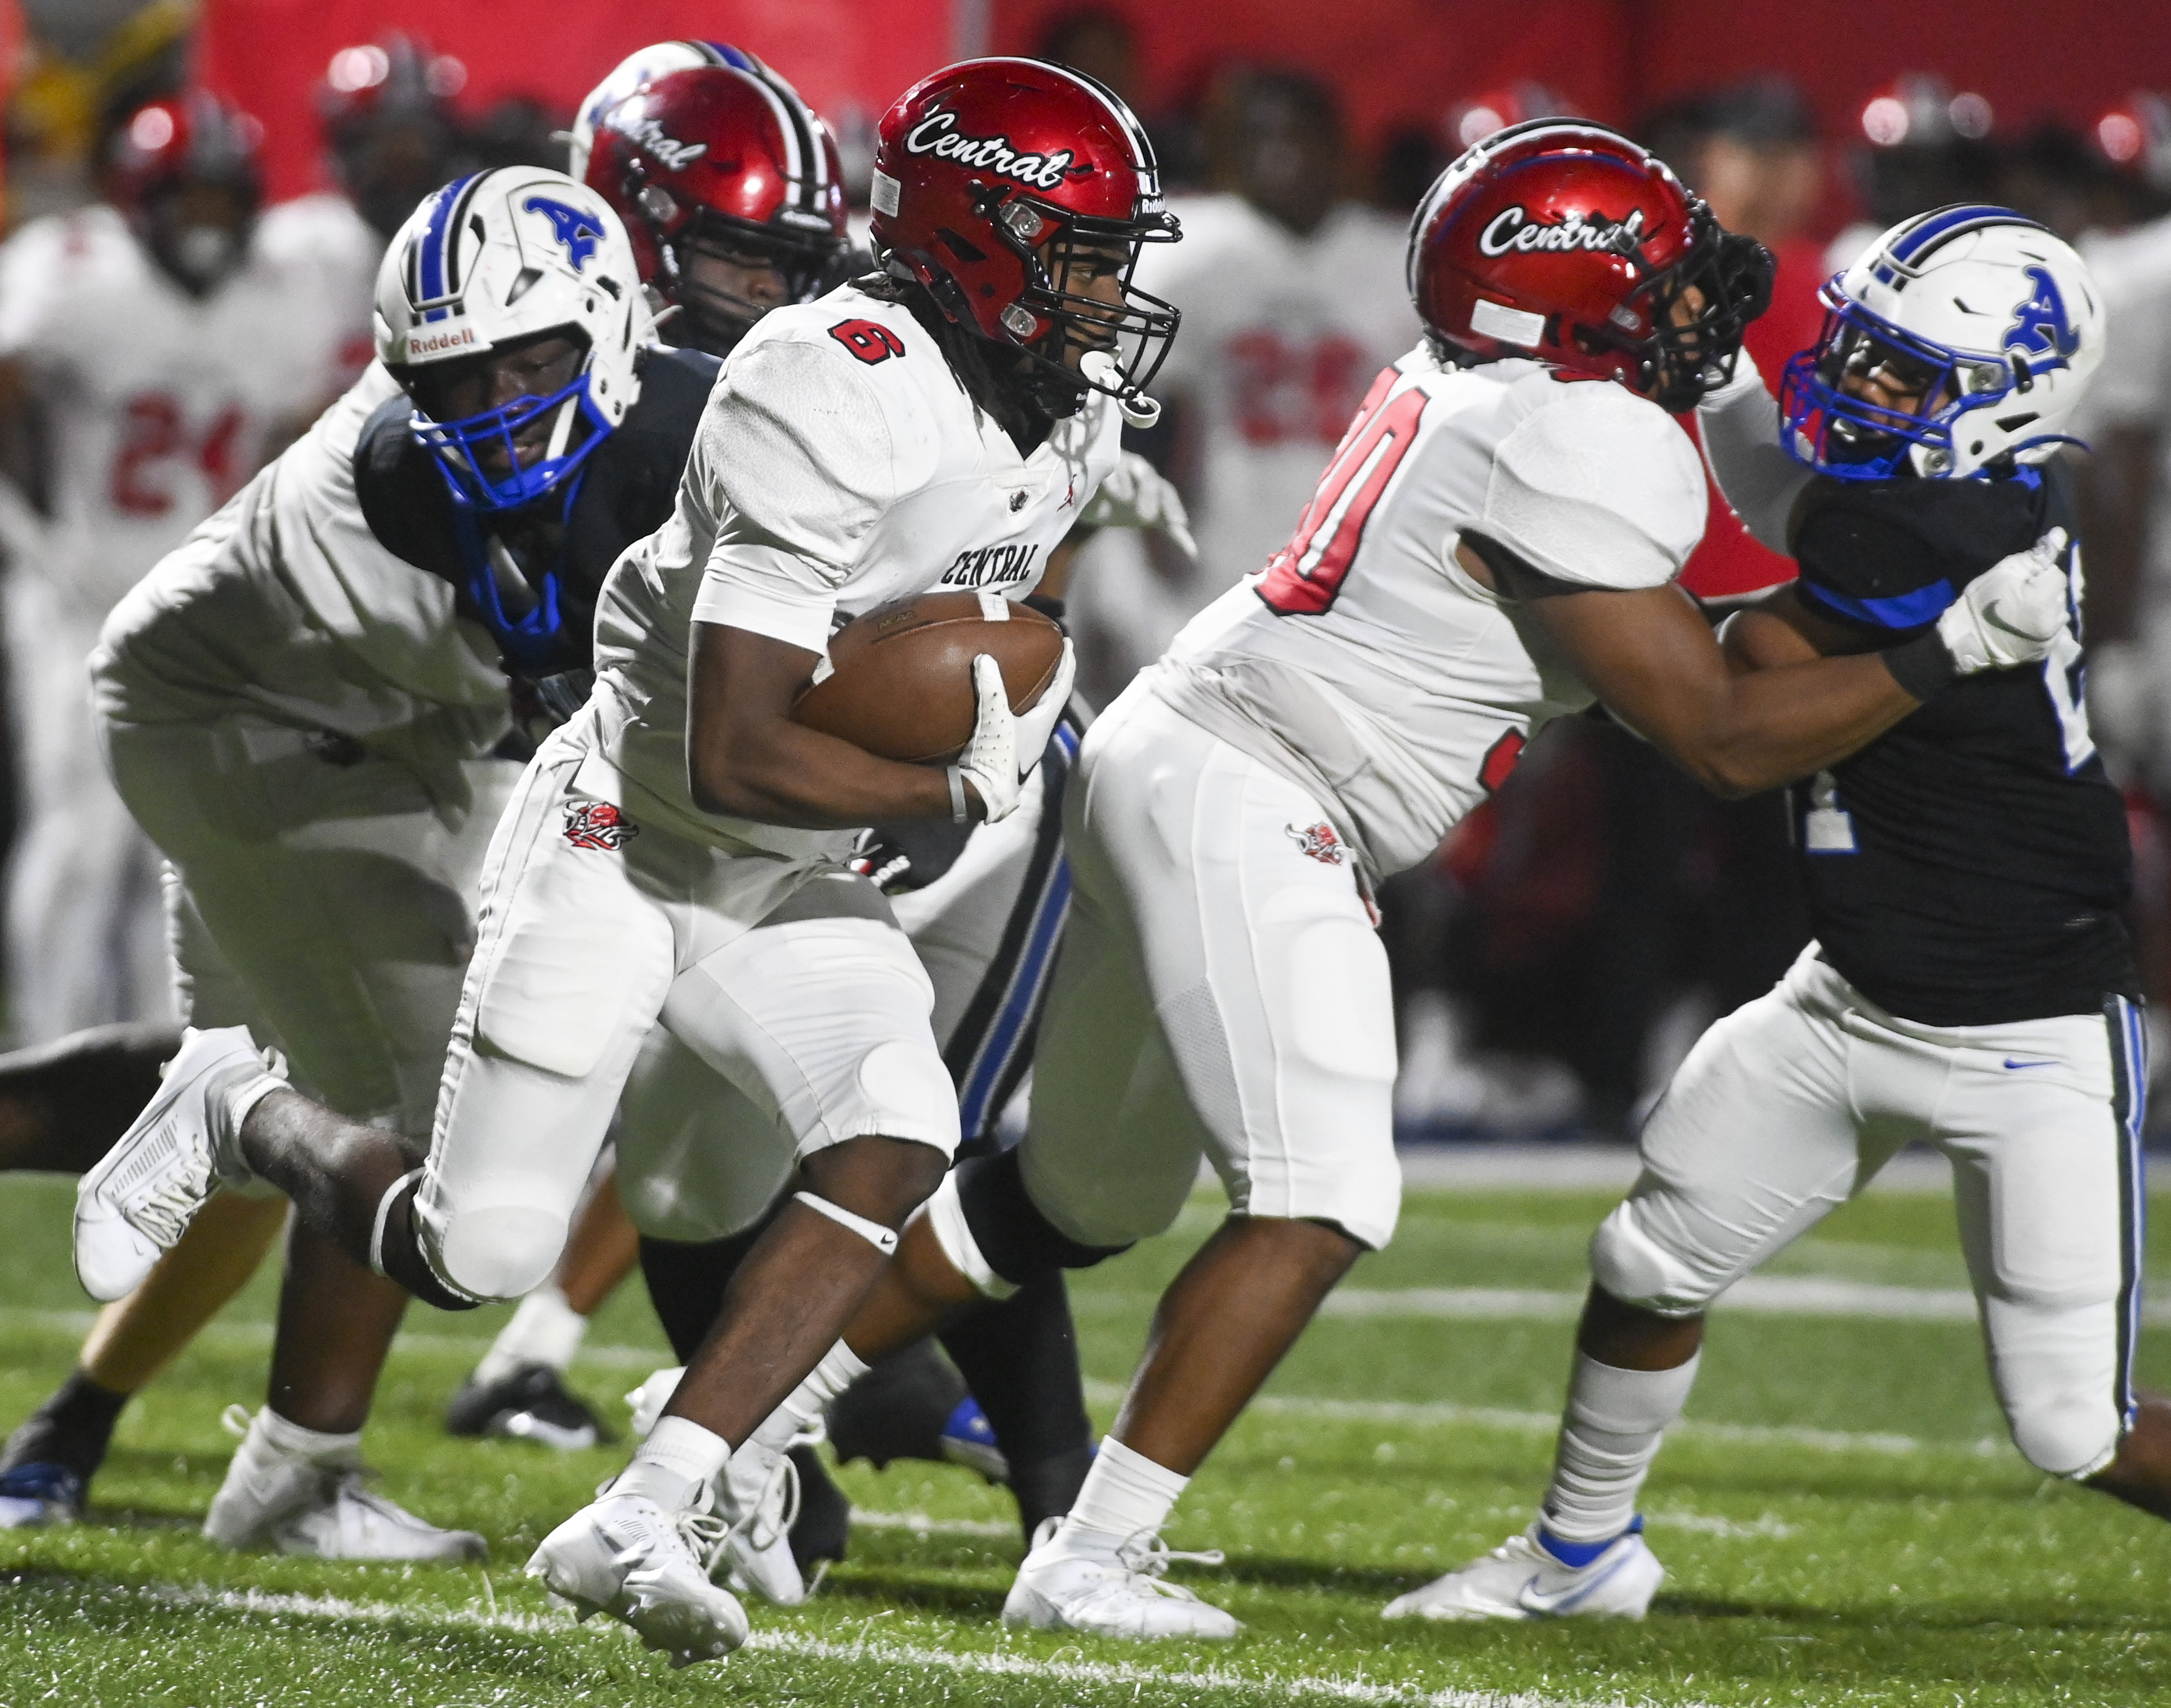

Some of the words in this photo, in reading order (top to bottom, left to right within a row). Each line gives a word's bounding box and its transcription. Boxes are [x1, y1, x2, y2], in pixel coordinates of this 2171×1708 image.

[605, 102, 707, 171] tral
[907, 113, 1070, 187] Central
[521, 195, 607, 275] A
[410, 328, 475, 354] Riddell
[827, 318, 906, 366] 6
[2001, 264, 2080, 358] A
[940, 543, 1038, 586] CENTRAL
